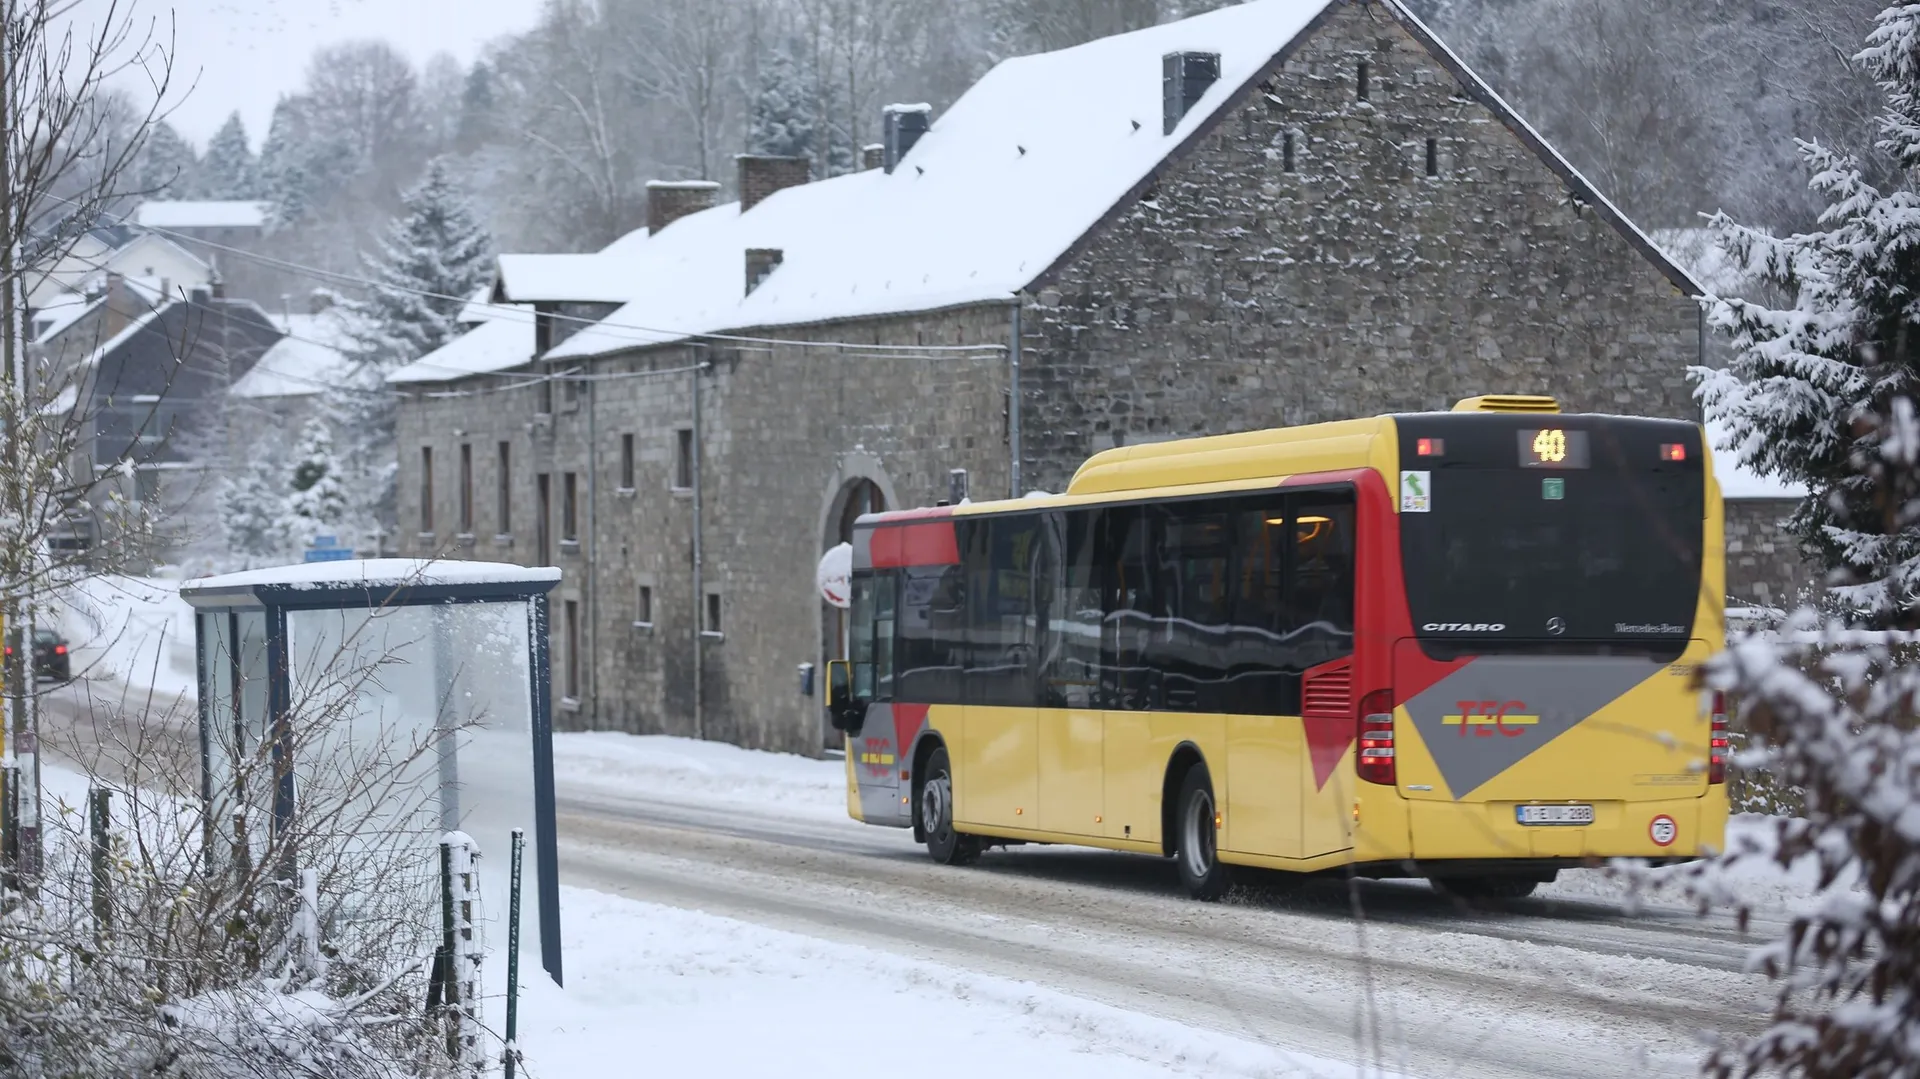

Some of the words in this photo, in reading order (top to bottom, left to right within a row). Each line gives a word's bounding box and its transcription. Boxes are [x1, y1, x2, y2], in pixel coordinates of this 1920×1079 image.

[1532, 429, 1566, 462] 40
[1422, 623, 1506, 632] CITARO
[1614, 622, 1686, 634] Mercedes-Benz
[1456, 700, 1527, 738] TEC
[1654, 822, 1672, 836] 75
